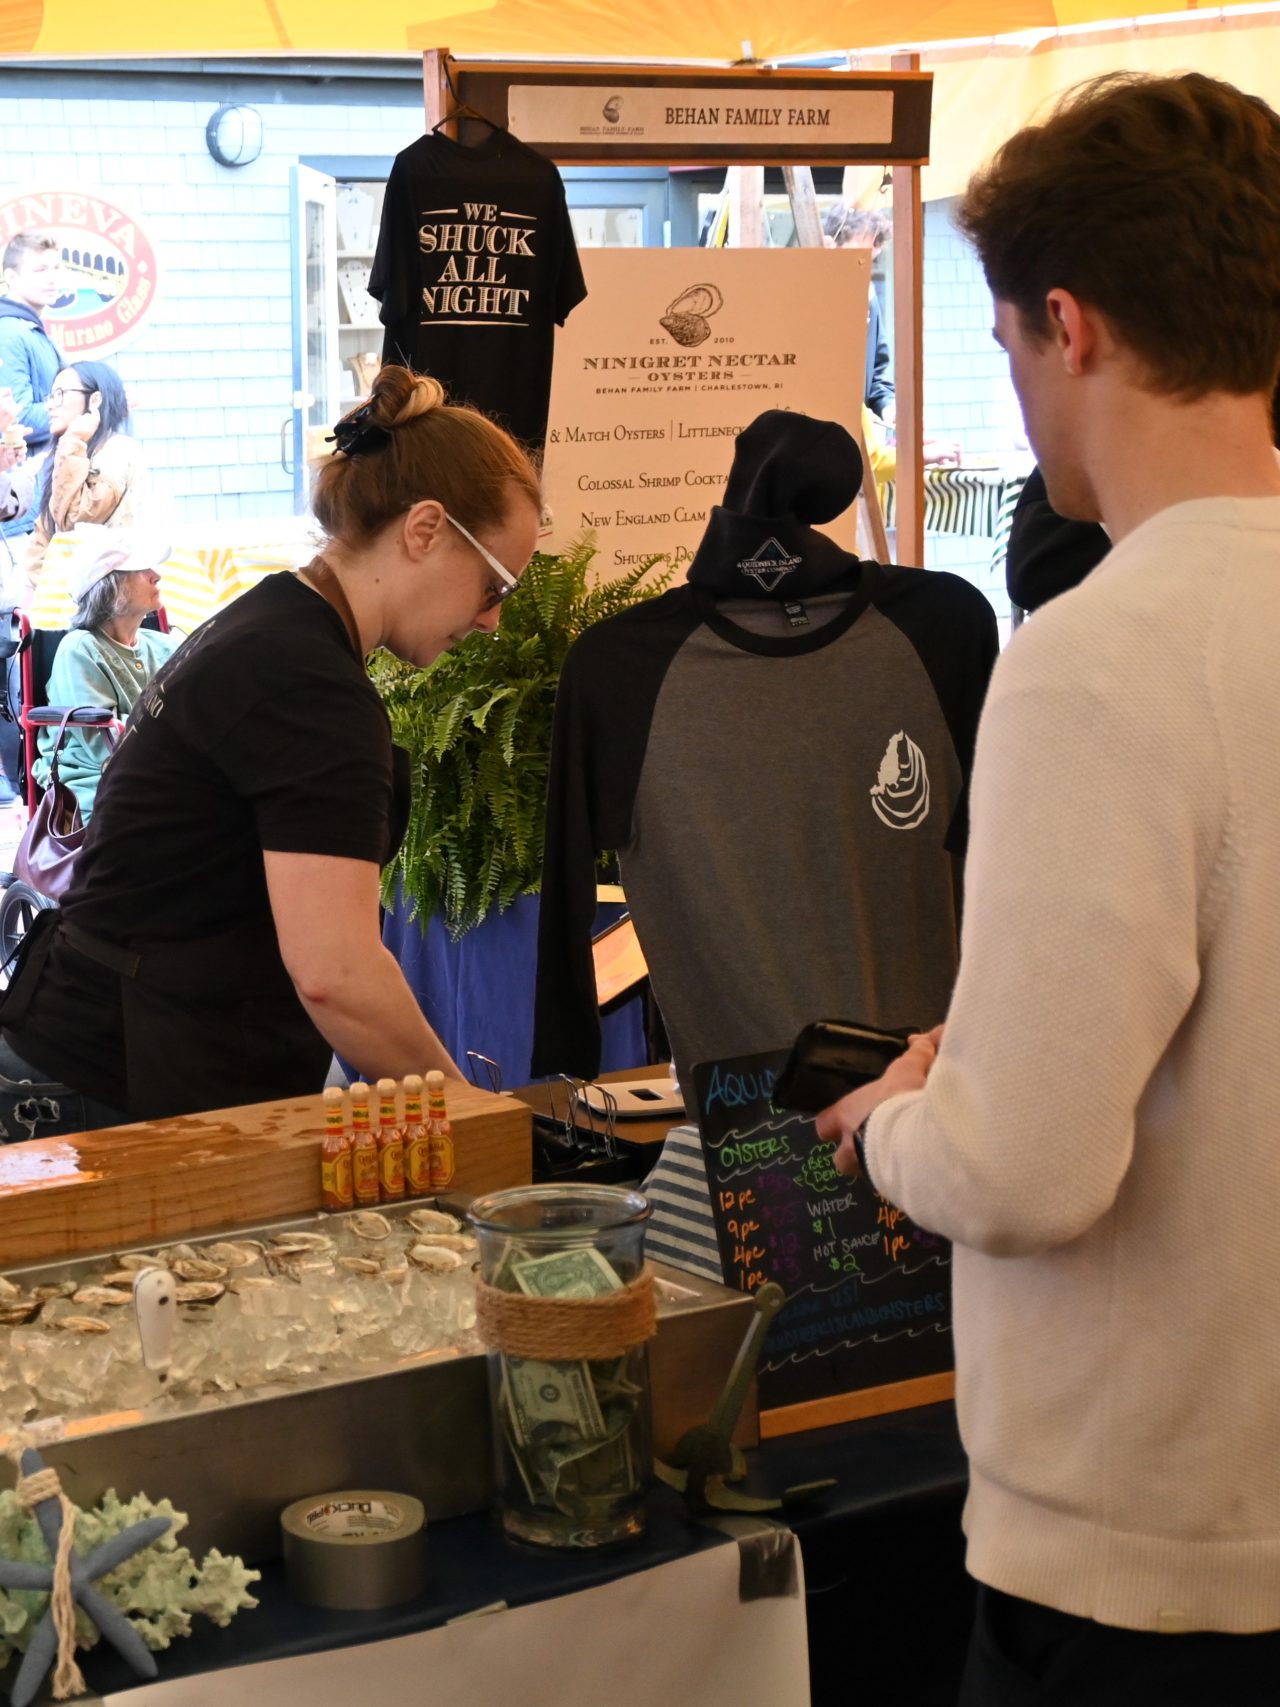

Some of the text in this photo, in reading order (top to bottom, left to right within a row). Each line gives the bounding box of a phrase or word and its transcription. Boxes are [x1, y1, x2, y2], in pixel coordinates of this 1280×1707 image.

[665, 107, 831, 126] BEHAN FAMILY FARM
[463, 202, 498, 222] WE
[418, 224, 536, 257] SHUCK
[437, 254, 507, 284] ALL
[422, 285, 530, 316] NIGHT
[50, 276, 152, 349] Murano Glass
[714, 336, 735, 344] 2010
[583, 353, 797, 370] NINIGRET NECTAR
[647, 370, 735, 382] OYSTERS
[595, 387, 628, 395] BEHAN
[631, 386, 663, 394] FAMILY
[666, 385, 691, 393] FARM
[701, 383, 771, 392] CHARLESTOWN,
[549, 430, 561, 443] &
[721, 1135, 791, 1167] OYSTERS
[807, 1192, 858, 1217] WATER
[813, 1231, 881, 1261] HOT SAUCE
[829, 1254, 861, 1272] $2
